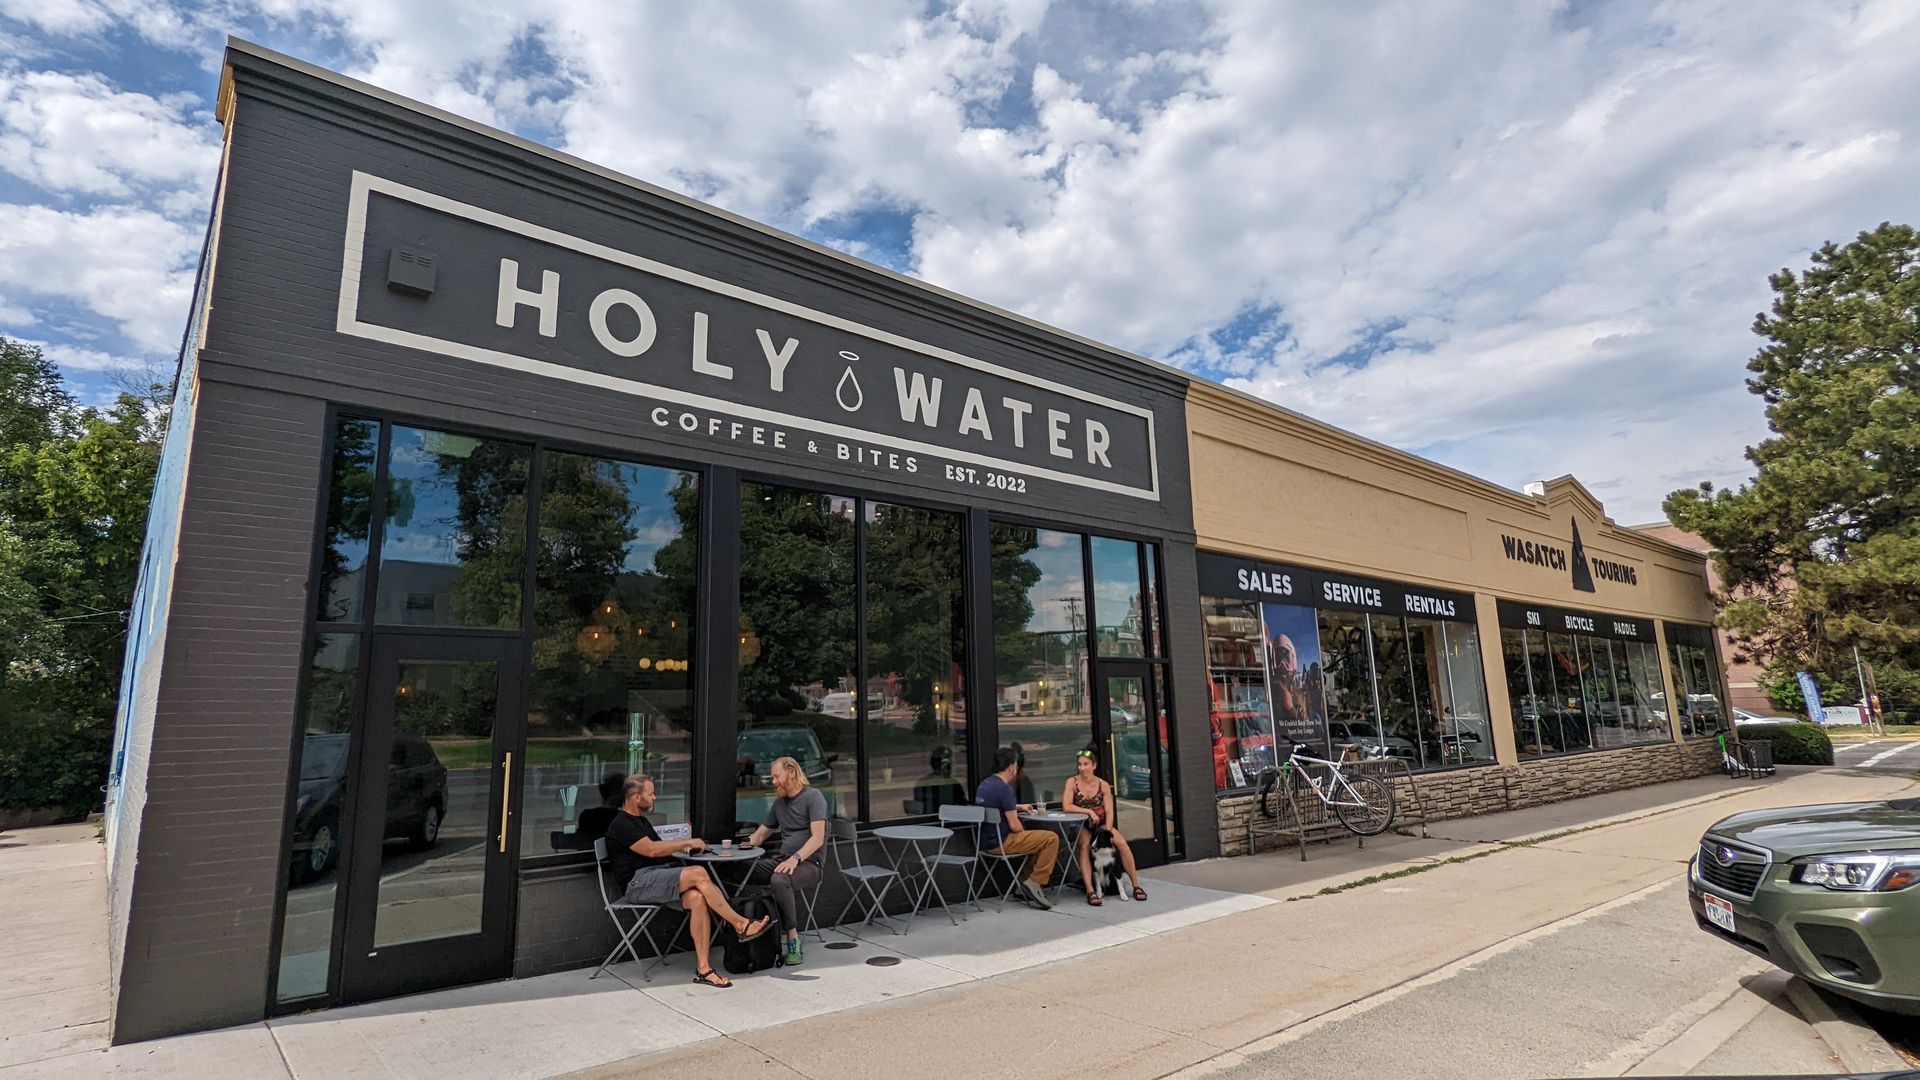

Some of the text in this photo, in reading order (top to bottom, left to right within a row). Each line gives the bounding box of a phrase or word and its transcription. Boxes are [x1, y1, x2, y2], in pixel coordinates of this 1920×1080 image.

[496, 258, 1112, 468] HOLY WATER
[651, 407, 1026, 493] COFFEE & BITES EST. 2022
[1501, 534, 1637, 586] WASATCH TOURING
[1238, 569, 1456, 617] SALES SERVICE RENTALS
[1526, 610, 1637, 636] SKI BICYCLE PADDLE
